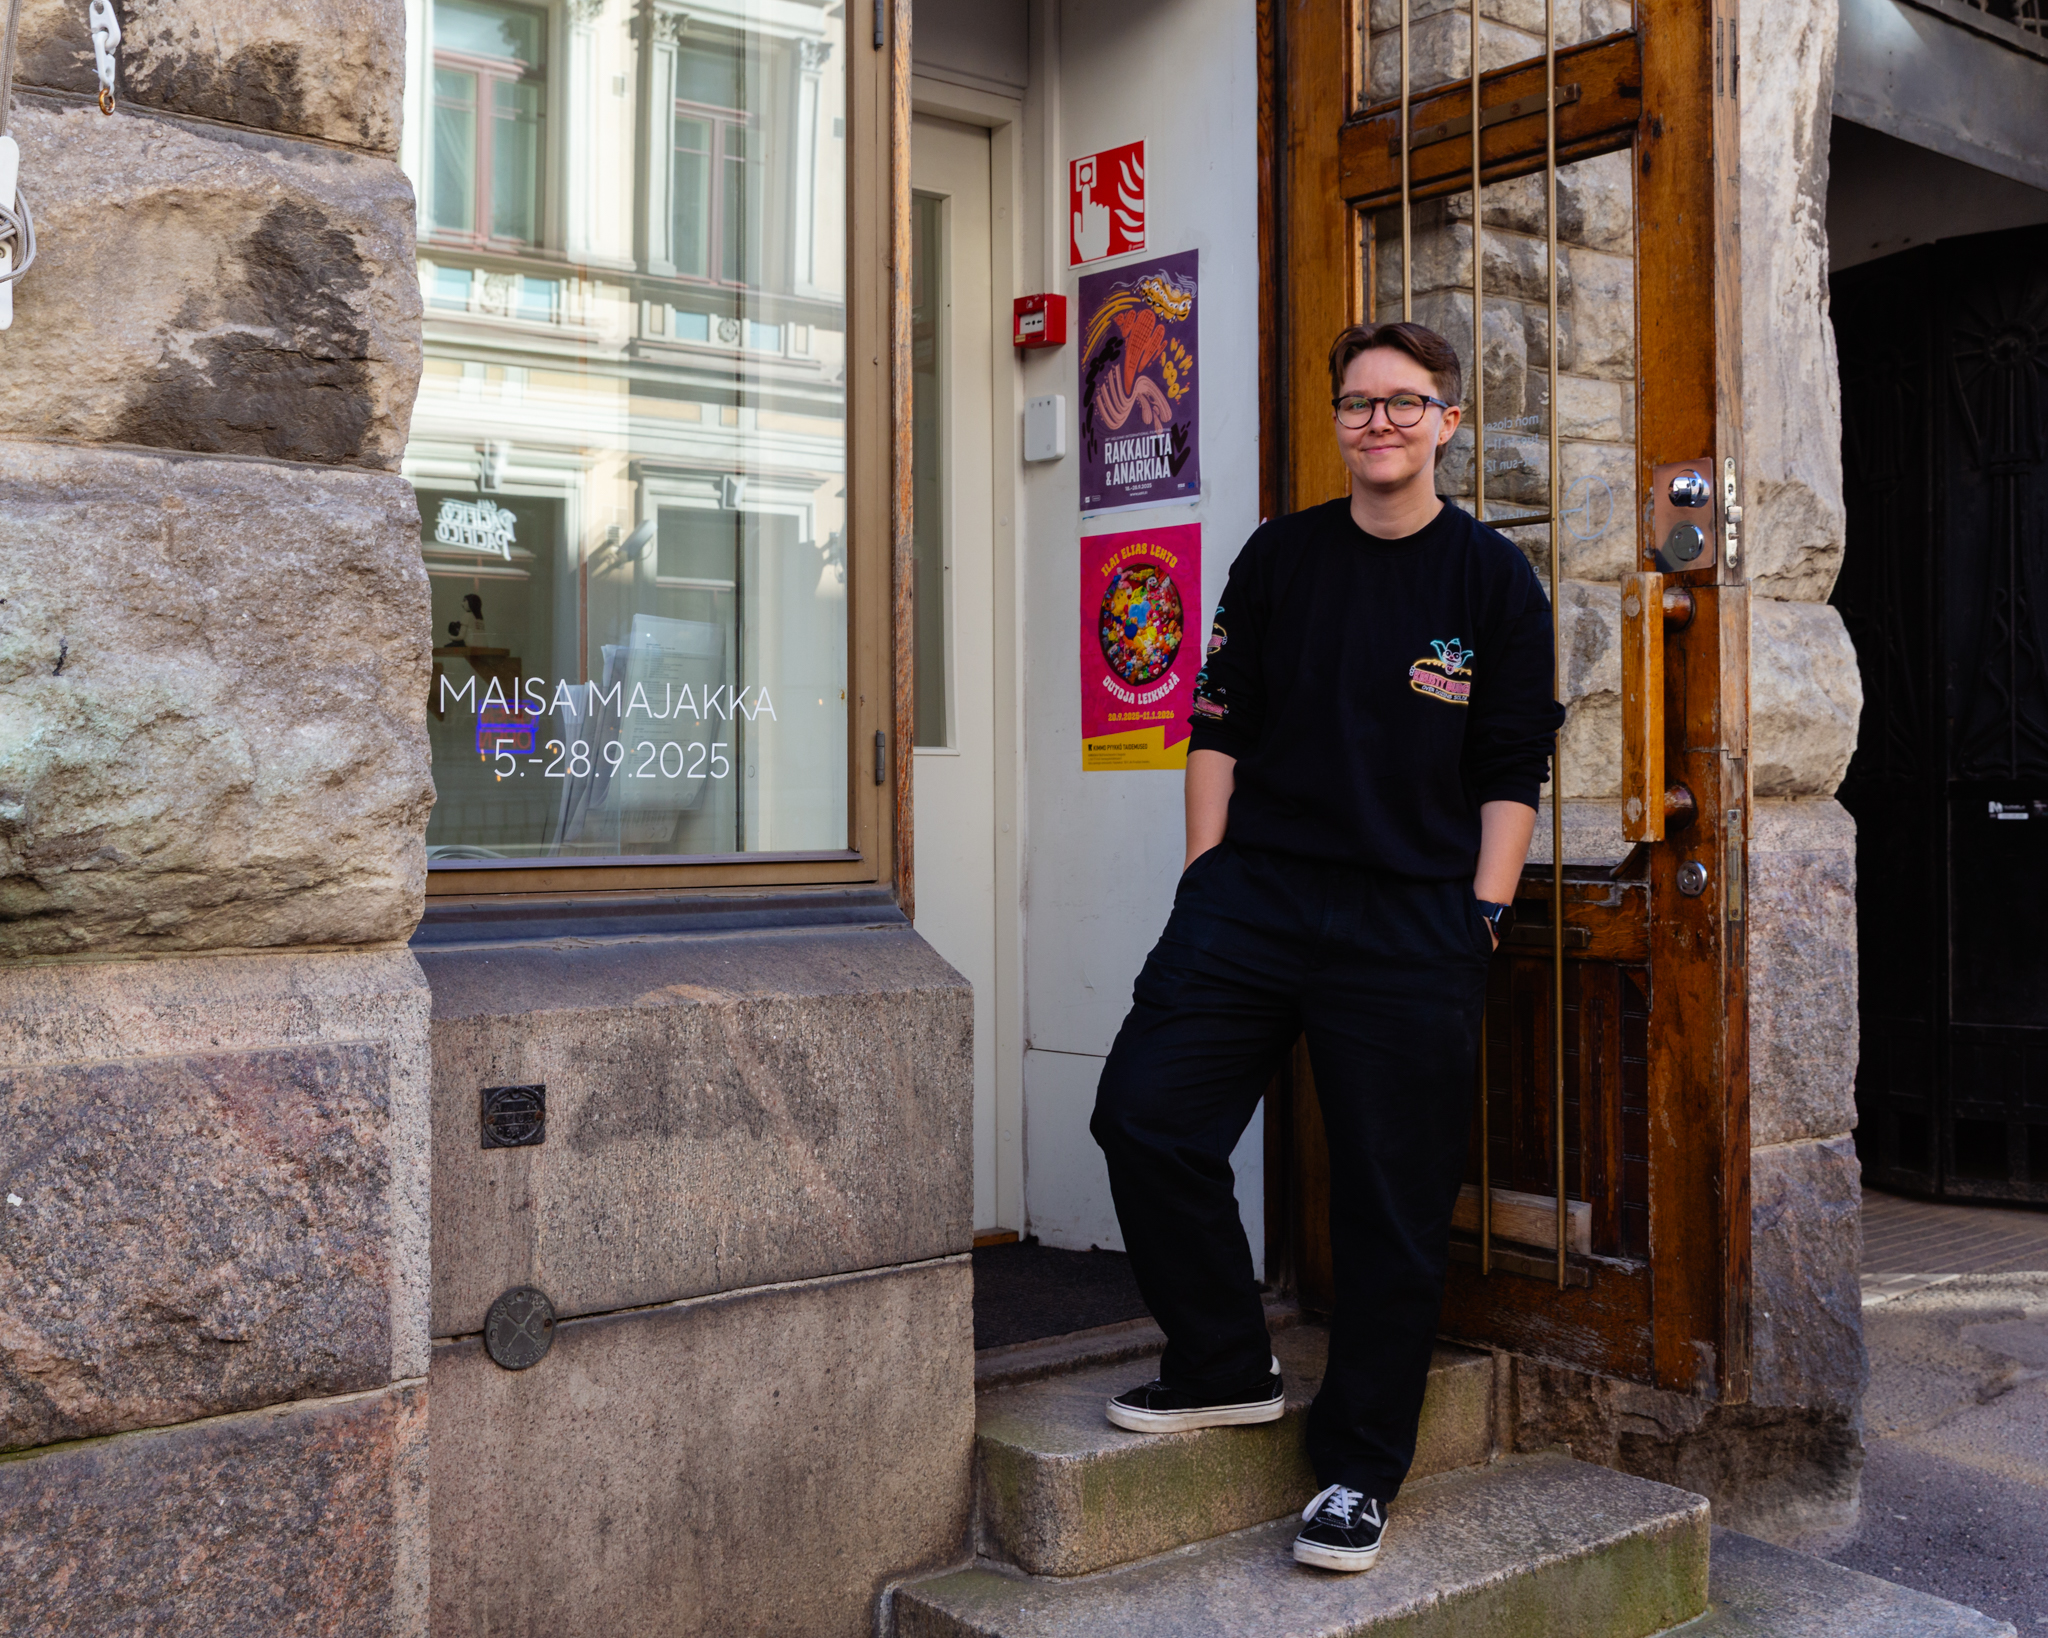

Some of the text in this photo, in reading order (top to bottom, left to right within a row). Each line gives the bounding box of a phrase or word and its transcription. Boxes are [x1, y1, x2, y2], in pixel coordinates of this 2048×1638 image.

[1104, 433, 1173, 465] RAKKAUTTA
[1105, 470, 1112, 486] &
[1112, 455, 1172, 486] ANARKIAA
[1100, 542, 1179, 577] ILAI ELIAS LEHTO
[439, 674, 777, 722] MAISA MAJAKKA
[1101, 671, 1181, 706] OUTOJA LEIKKEJÄ
